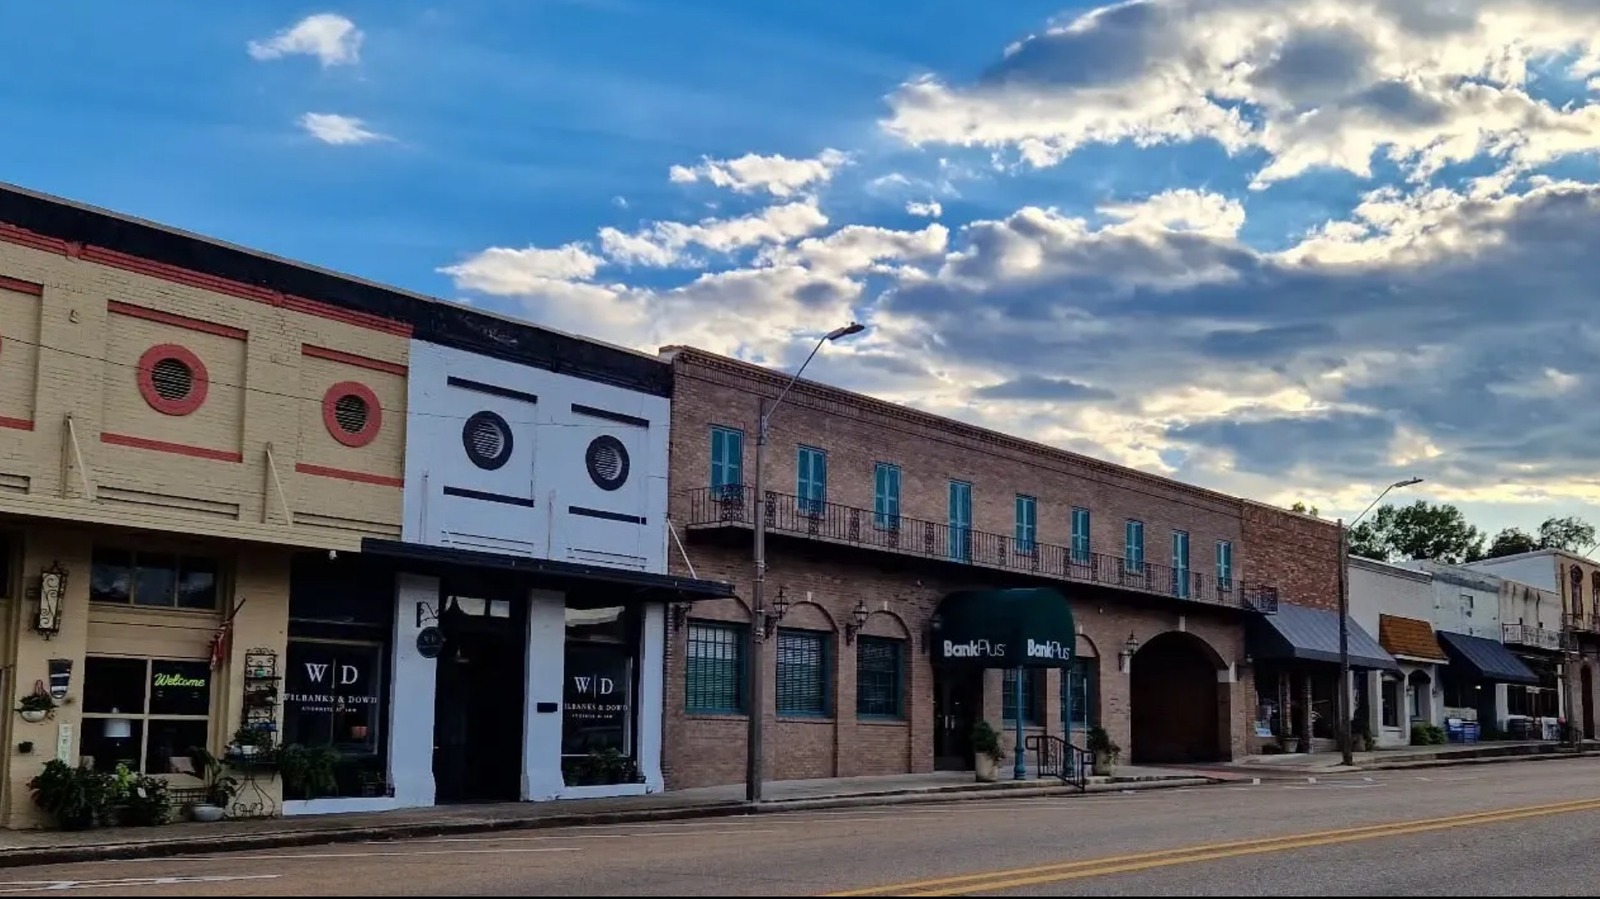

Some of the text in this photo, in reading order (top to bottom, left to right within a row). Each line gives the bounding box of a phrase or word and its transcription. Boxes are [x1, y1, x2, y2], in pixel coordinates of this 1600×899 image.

[943, 639, 1005, 657] BankPlus
[1027, 638, 1070, 660] BankPlus
[154, 673, 205, 687] Welcome
[304, 662, 359, 684] W D
[574, 676, 614, 695] W D
[564, 702, 596, 711] ILBANKS
